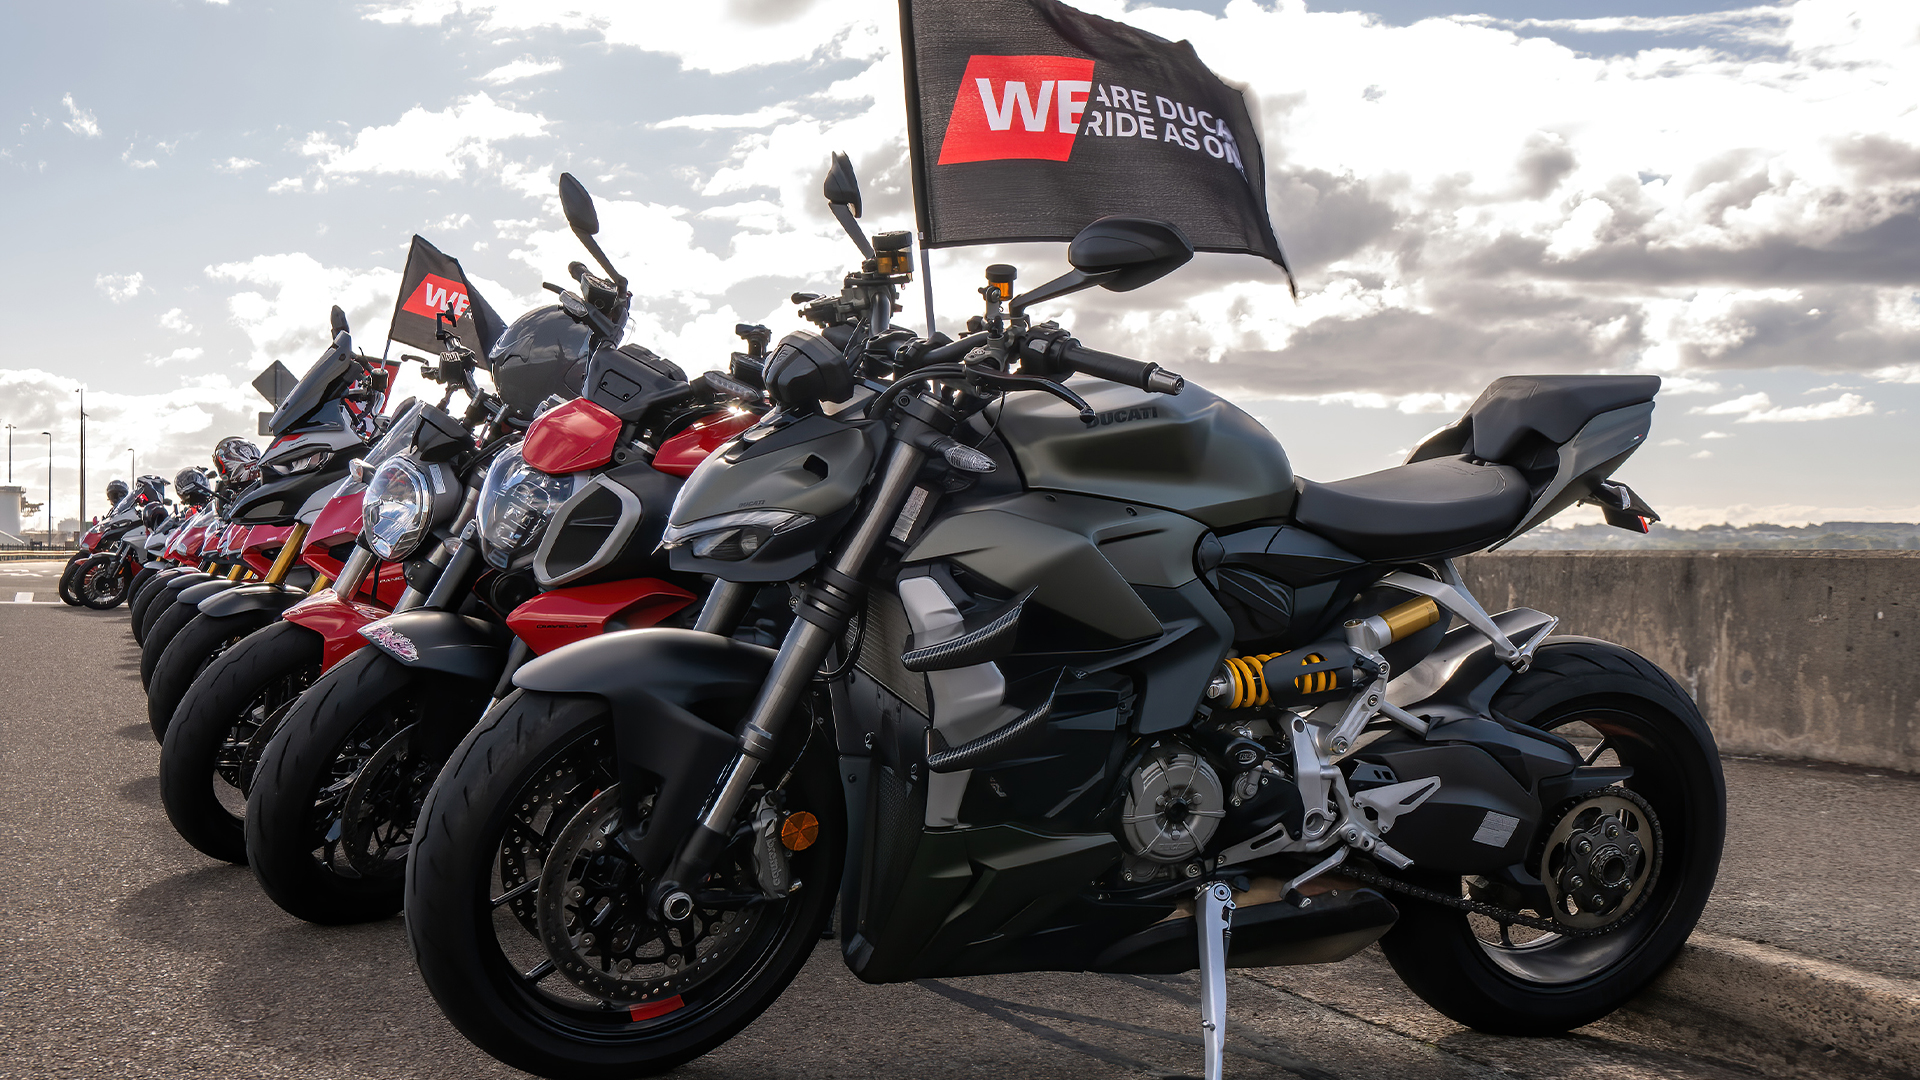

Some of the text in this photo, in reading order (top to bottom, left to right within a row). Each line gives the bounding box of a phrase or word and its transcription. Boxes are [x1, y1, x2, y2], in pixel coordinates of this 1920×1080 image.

[974, 77, 1093, 135] WE
[1096, 83, 1234, 142] ARE DUCA
[1084, 110, 1244, 171] RIDE AS ON
[425, 282, 470, 317] WE
[765, 838, 782, 886] brembo
